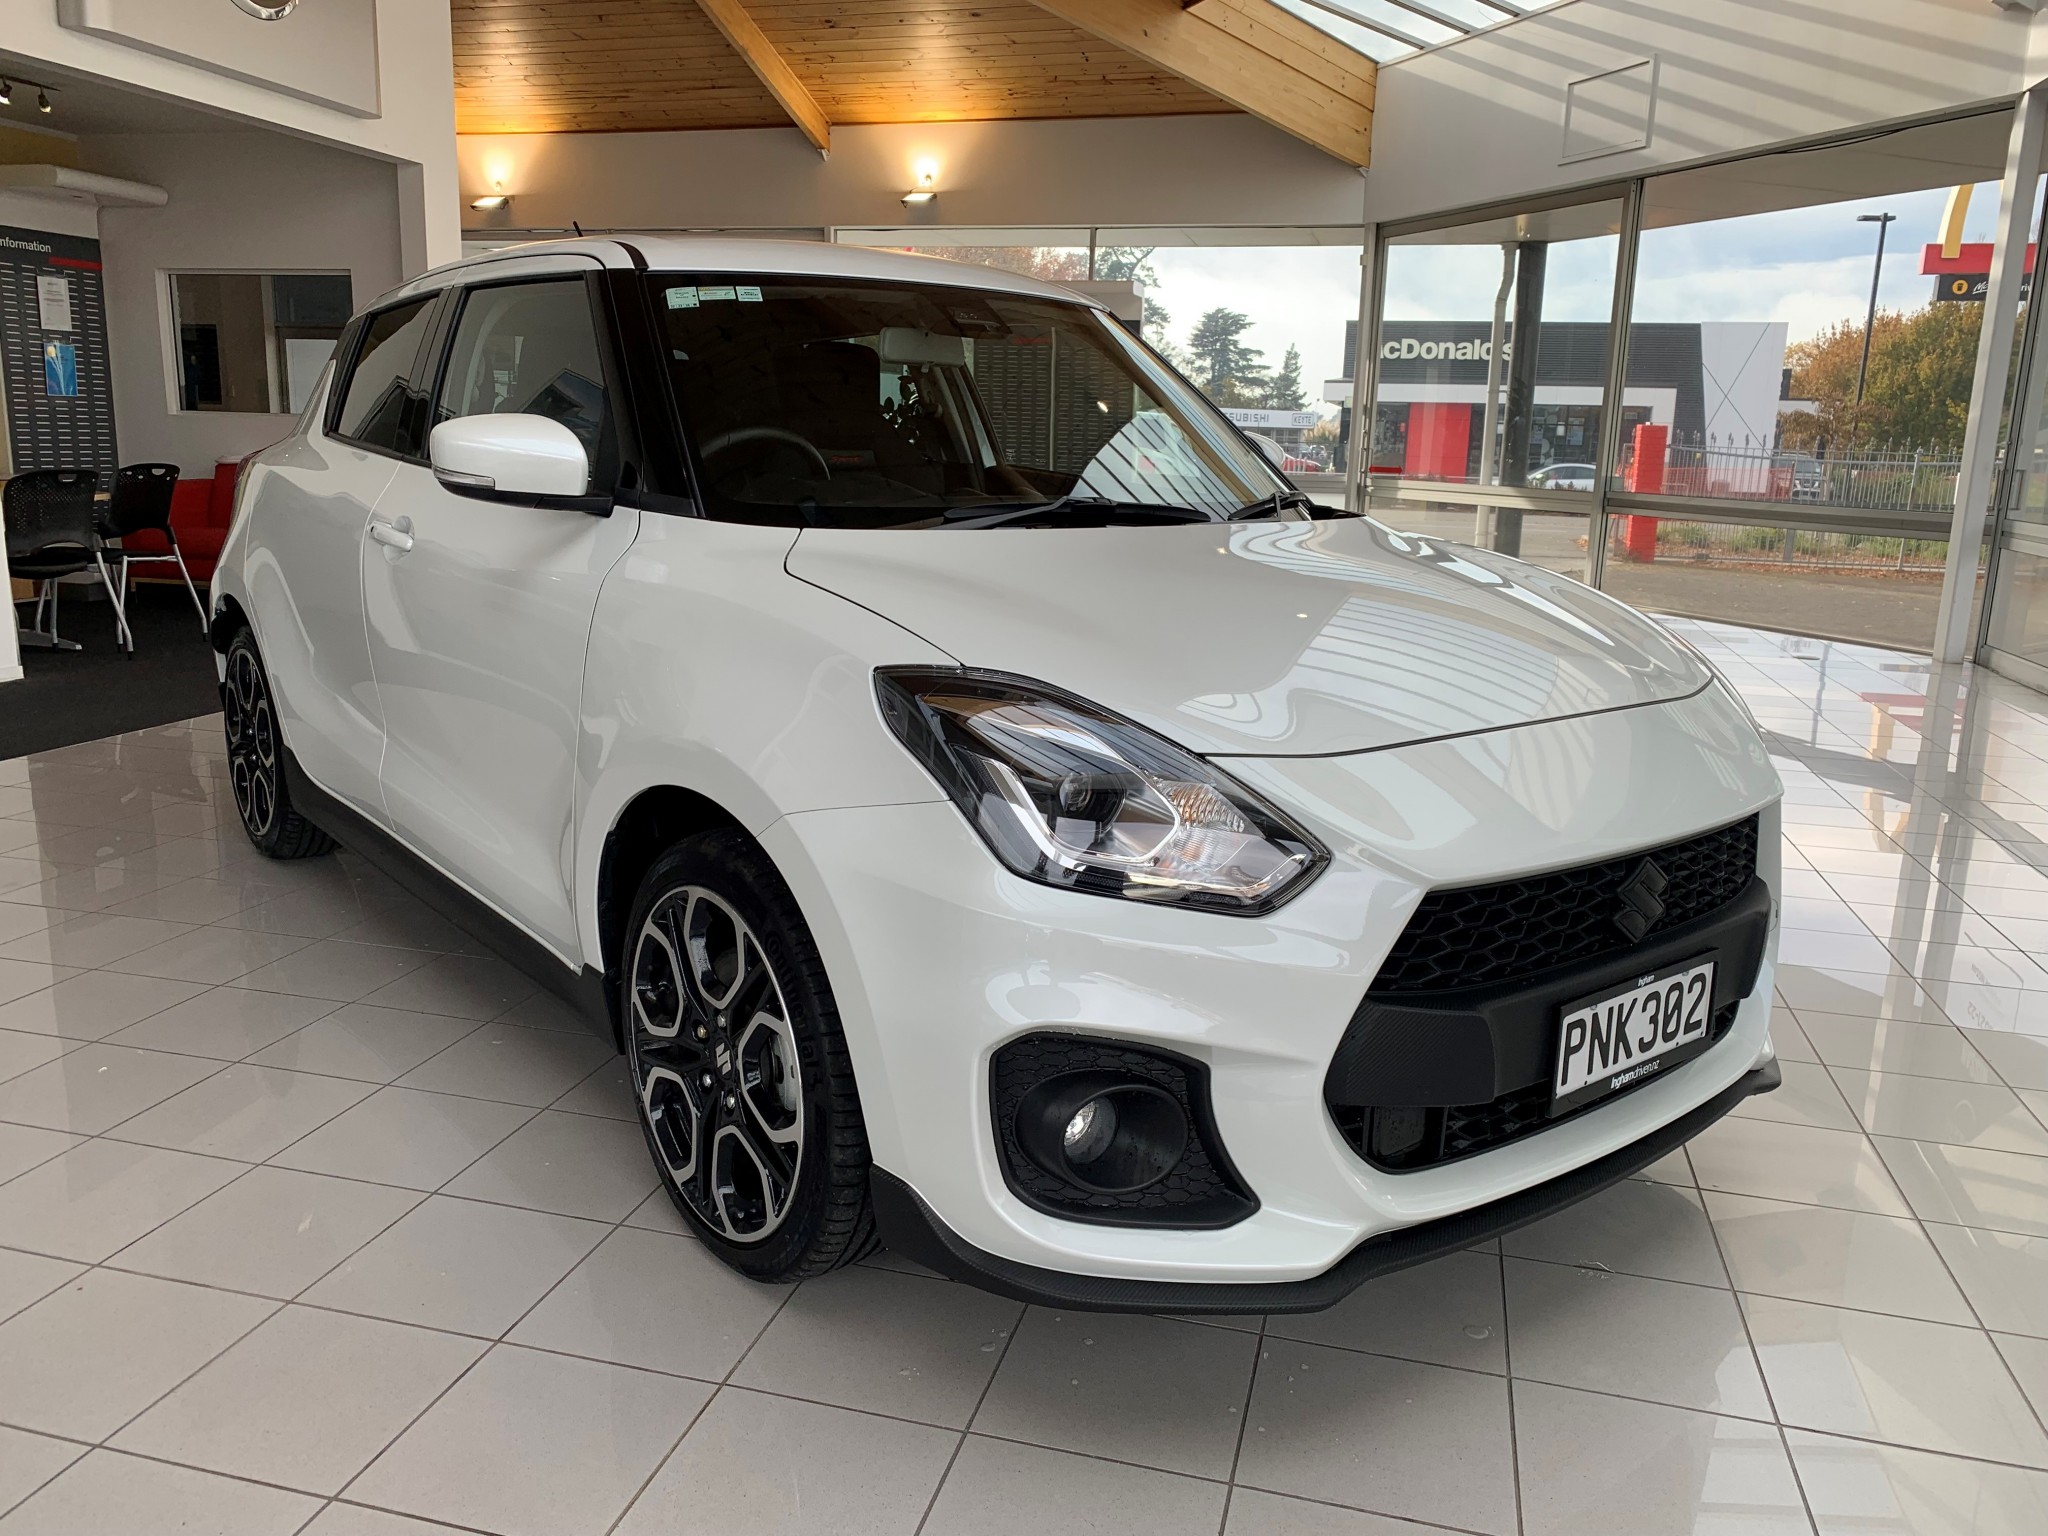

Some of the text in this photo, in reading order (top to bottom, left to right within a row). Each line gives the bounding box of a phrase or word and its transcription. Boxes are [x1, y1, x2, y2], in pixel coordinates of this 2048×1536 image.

[0, 236, 52, 253] nformation
[1226, 411, 1270, 423] SUBISHI
[1560, 972, 1707, 1087] PNK302
